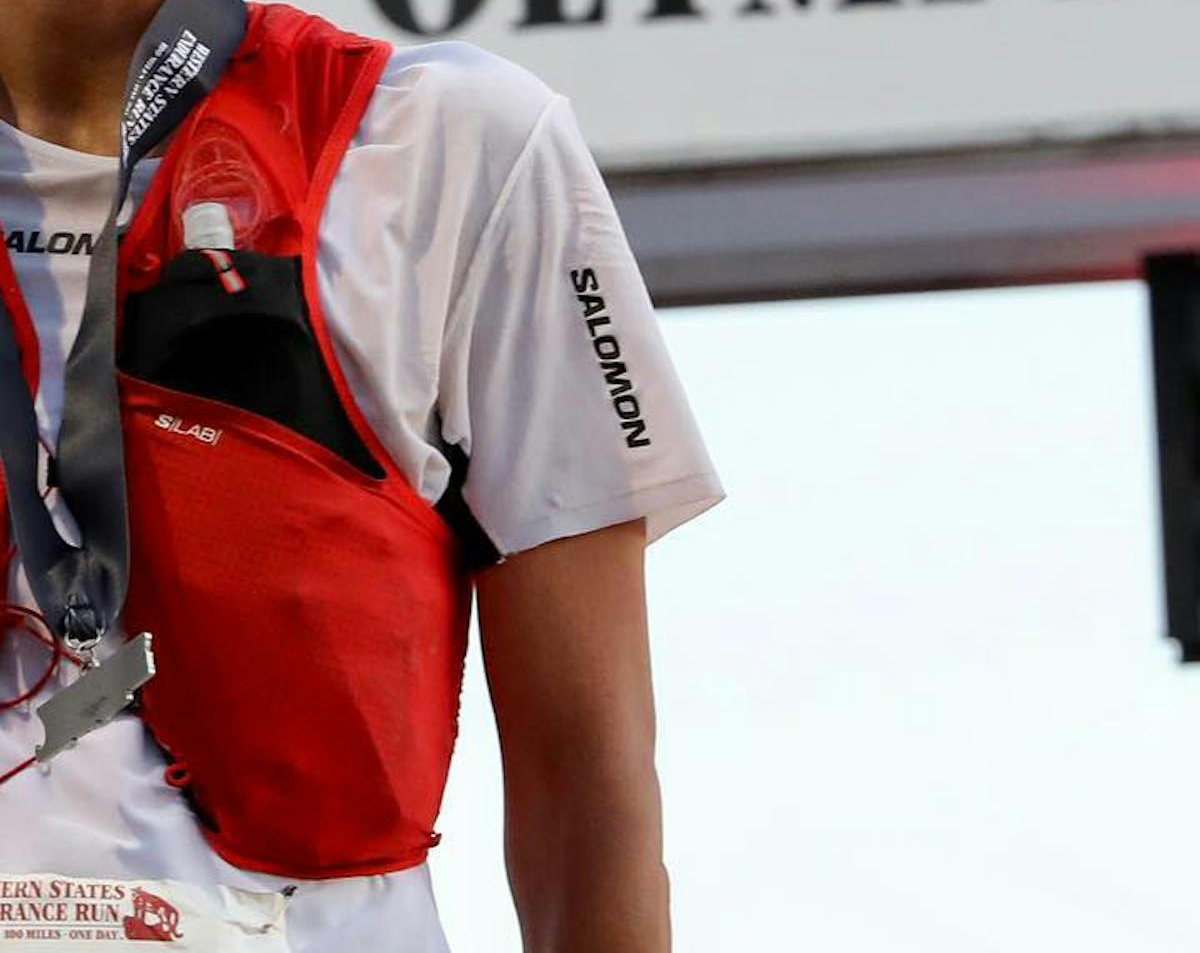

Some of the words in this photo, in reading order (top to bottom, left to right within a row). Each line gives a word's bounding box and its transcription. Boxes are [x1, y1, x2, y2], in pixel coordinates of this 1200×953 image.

[569, 267, 652, 449] SALOMON
[49, 880, 126, 900] STATES
[74, 903, 120, 923] RUN
[25, 929, 62, 940] MILES
[68, 929, 92, 940] ONE
